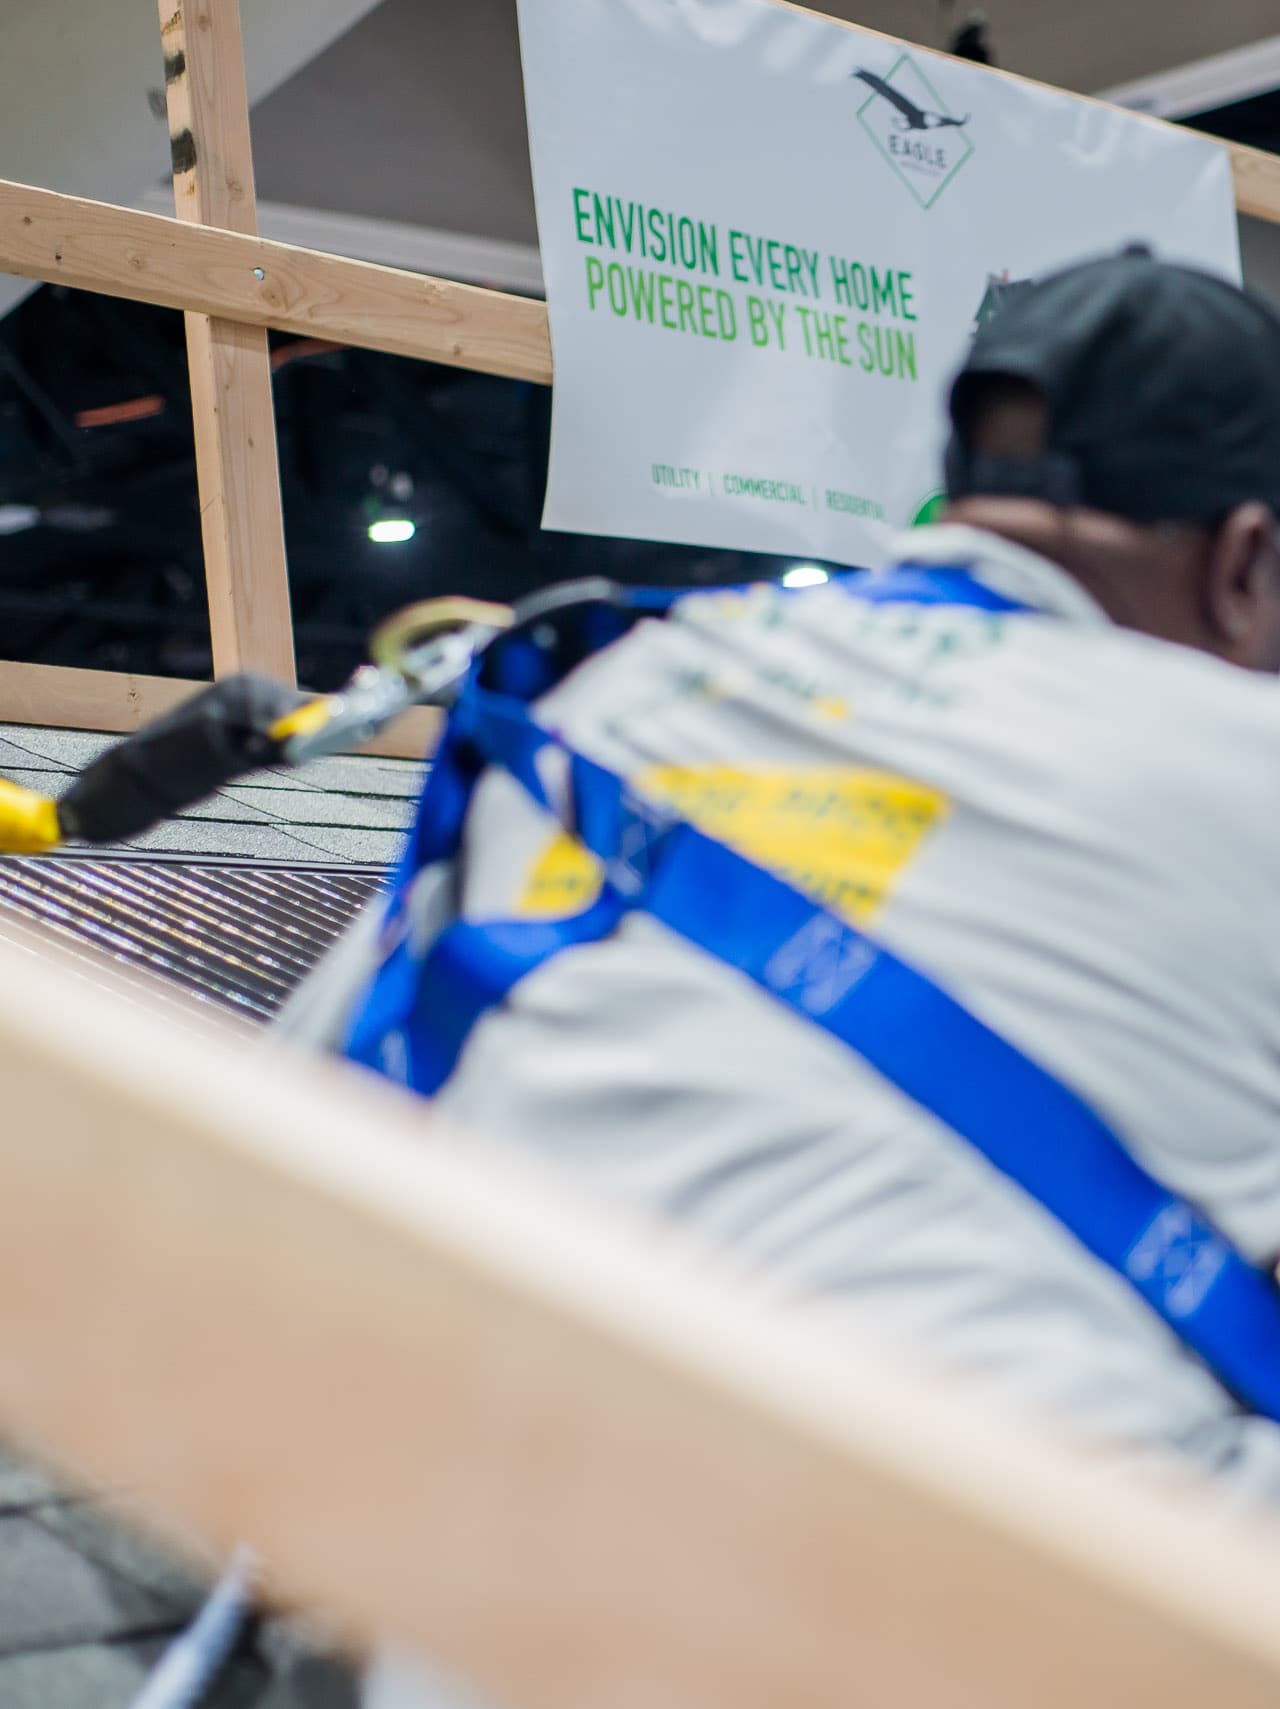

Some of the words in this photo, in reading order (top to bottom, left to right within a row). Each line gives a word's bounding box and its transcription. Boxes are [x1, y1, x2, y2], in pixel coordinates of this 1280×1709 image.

[888, 134, 947, 169] EAGLE
[572, 187, 719, 276] ENVISION
[728, 229, 820, 299] EVERY
[829, 255, 917, 322] HOME
[585, 255, 738, 342] POWERED
[746, 295, 785, 352] BY
[795, 305, 852, 366] THE
[857, 321, 918, 381] SUN
[652, 463, 699, 490] UTILITY
[722, 473, 807, 505] COMMERCIAL
